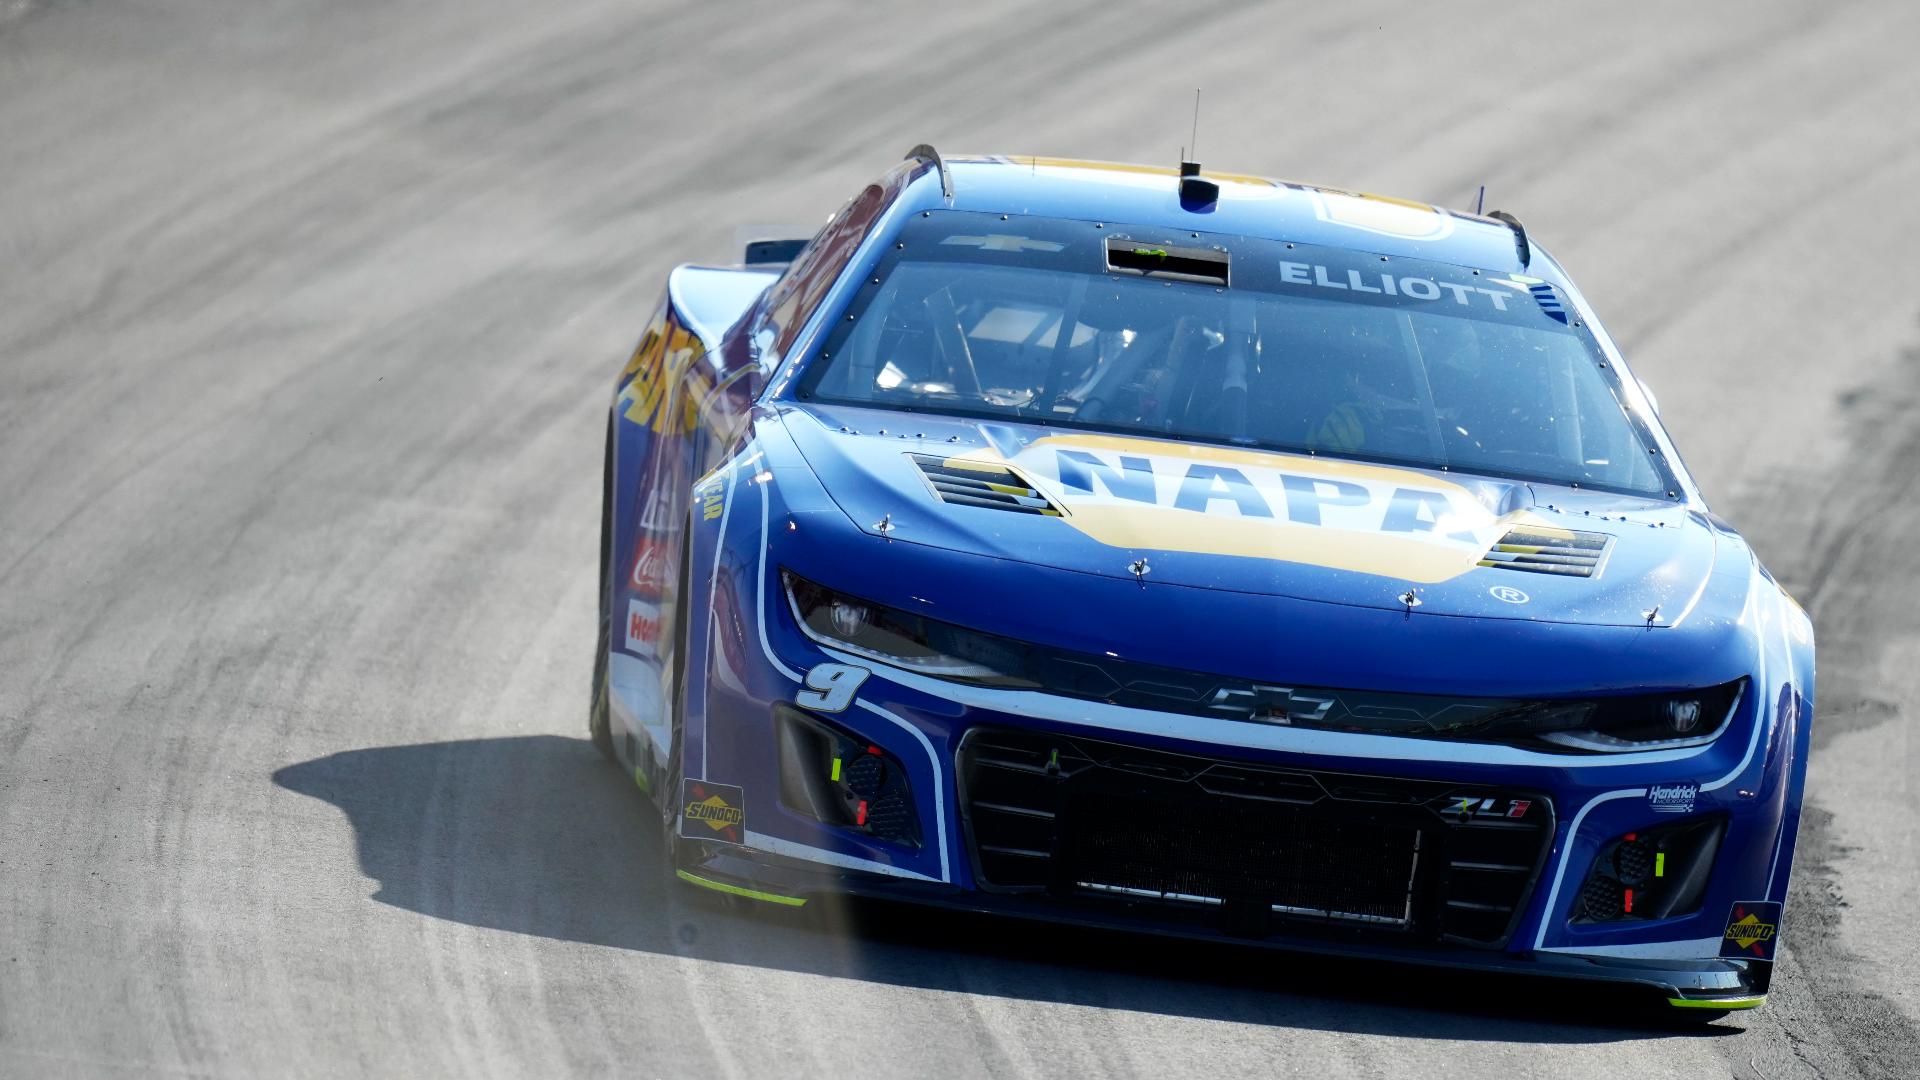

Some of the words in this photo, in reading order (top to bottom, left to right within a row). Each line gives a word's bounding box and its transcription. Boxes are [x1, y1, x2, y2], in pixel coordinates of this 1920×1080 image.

[1279, 261, 1512, 311] ELLIOTT
[1055, 449, 1479, 544] NAPA
[796, 663, 871, 712] 9
[1649, 785, 1696, 803] Hendrick
[687, 803, 740, 824] SUNOCO
[1440, 796, 1531, 818] ZL1
[1727, 924, 1773, 939] SUNOCO
